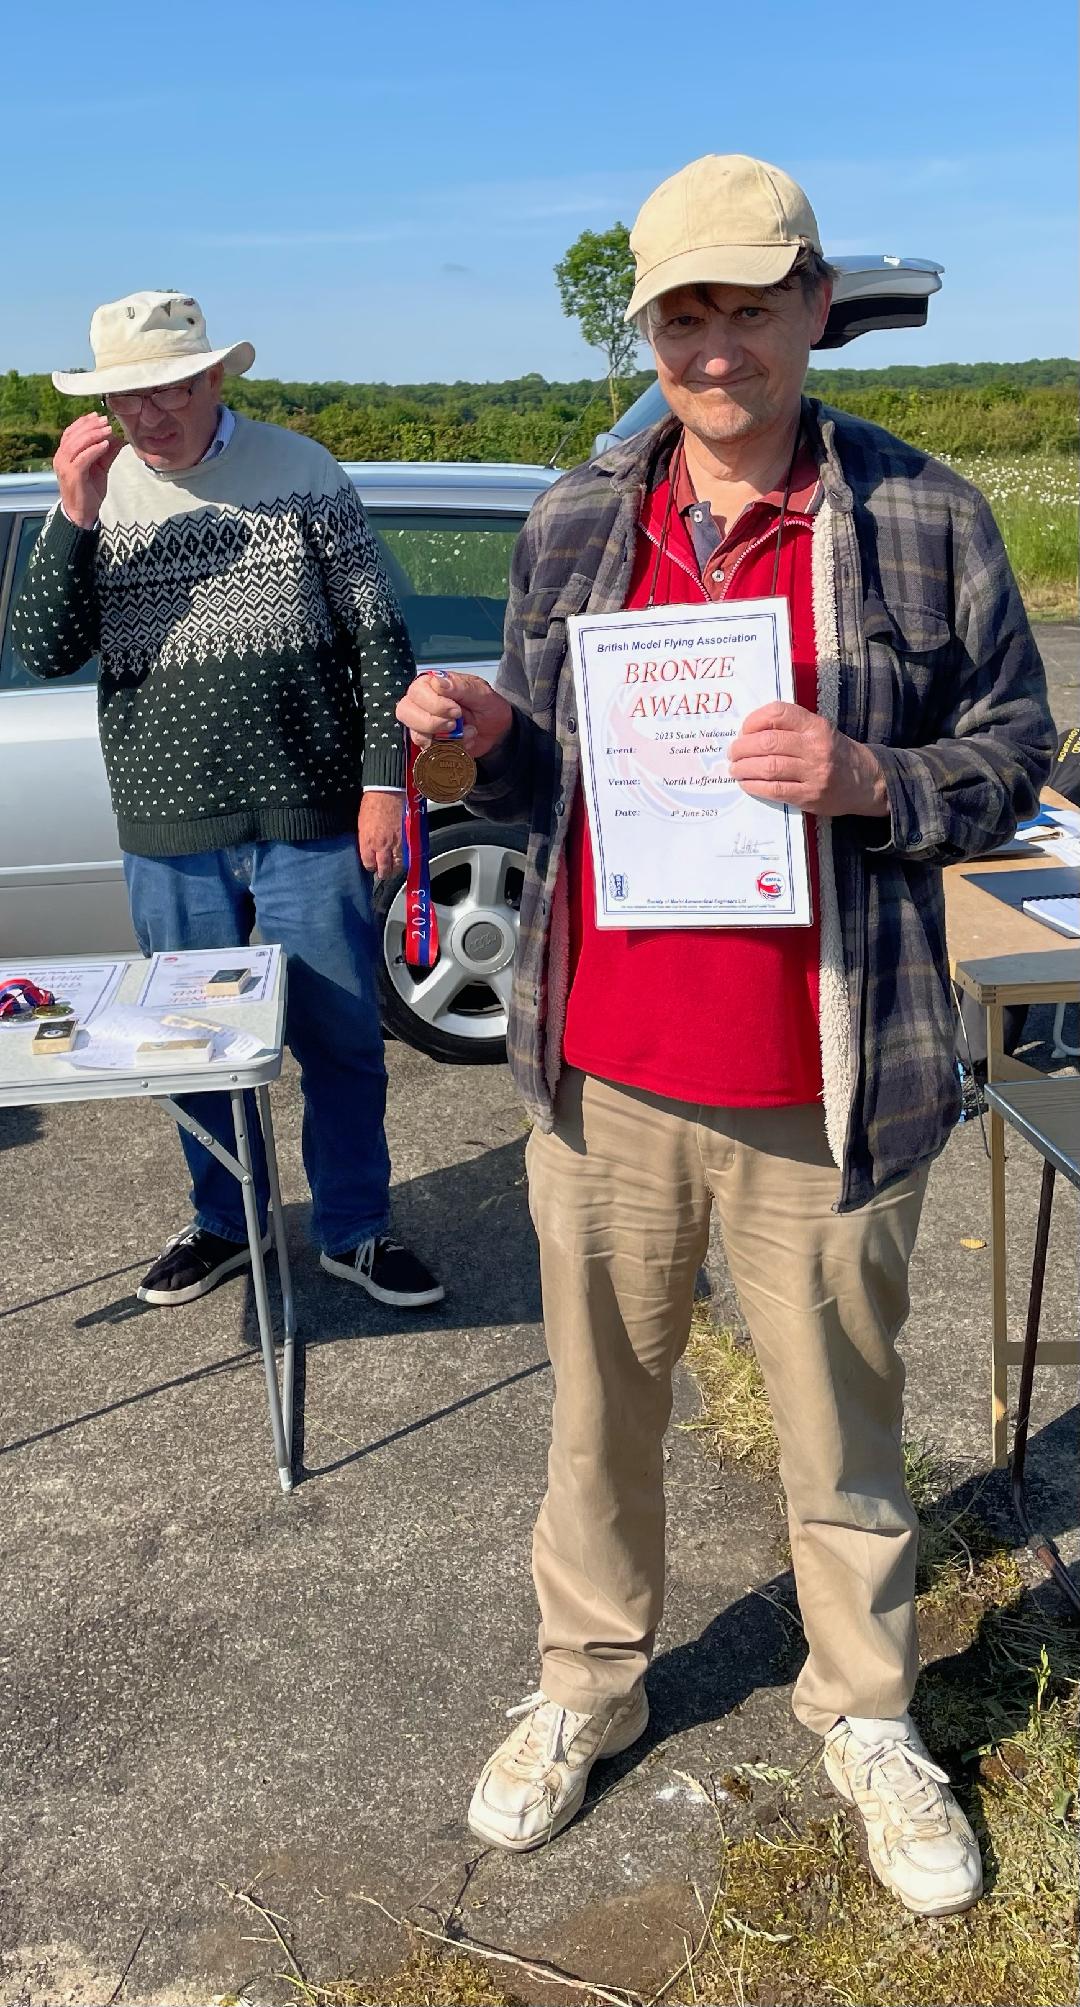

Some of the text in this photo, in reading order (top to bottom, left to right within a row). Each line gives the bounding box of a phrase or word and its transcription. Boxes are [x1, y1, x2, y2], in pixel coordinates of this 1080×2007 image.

[597, 633, 757, 653] British Model Flying Association
[623, 656, 736, 684] BRONZE
[630, 692, 733, 718] AWARD
[411, 889, 426, 940] 2023
